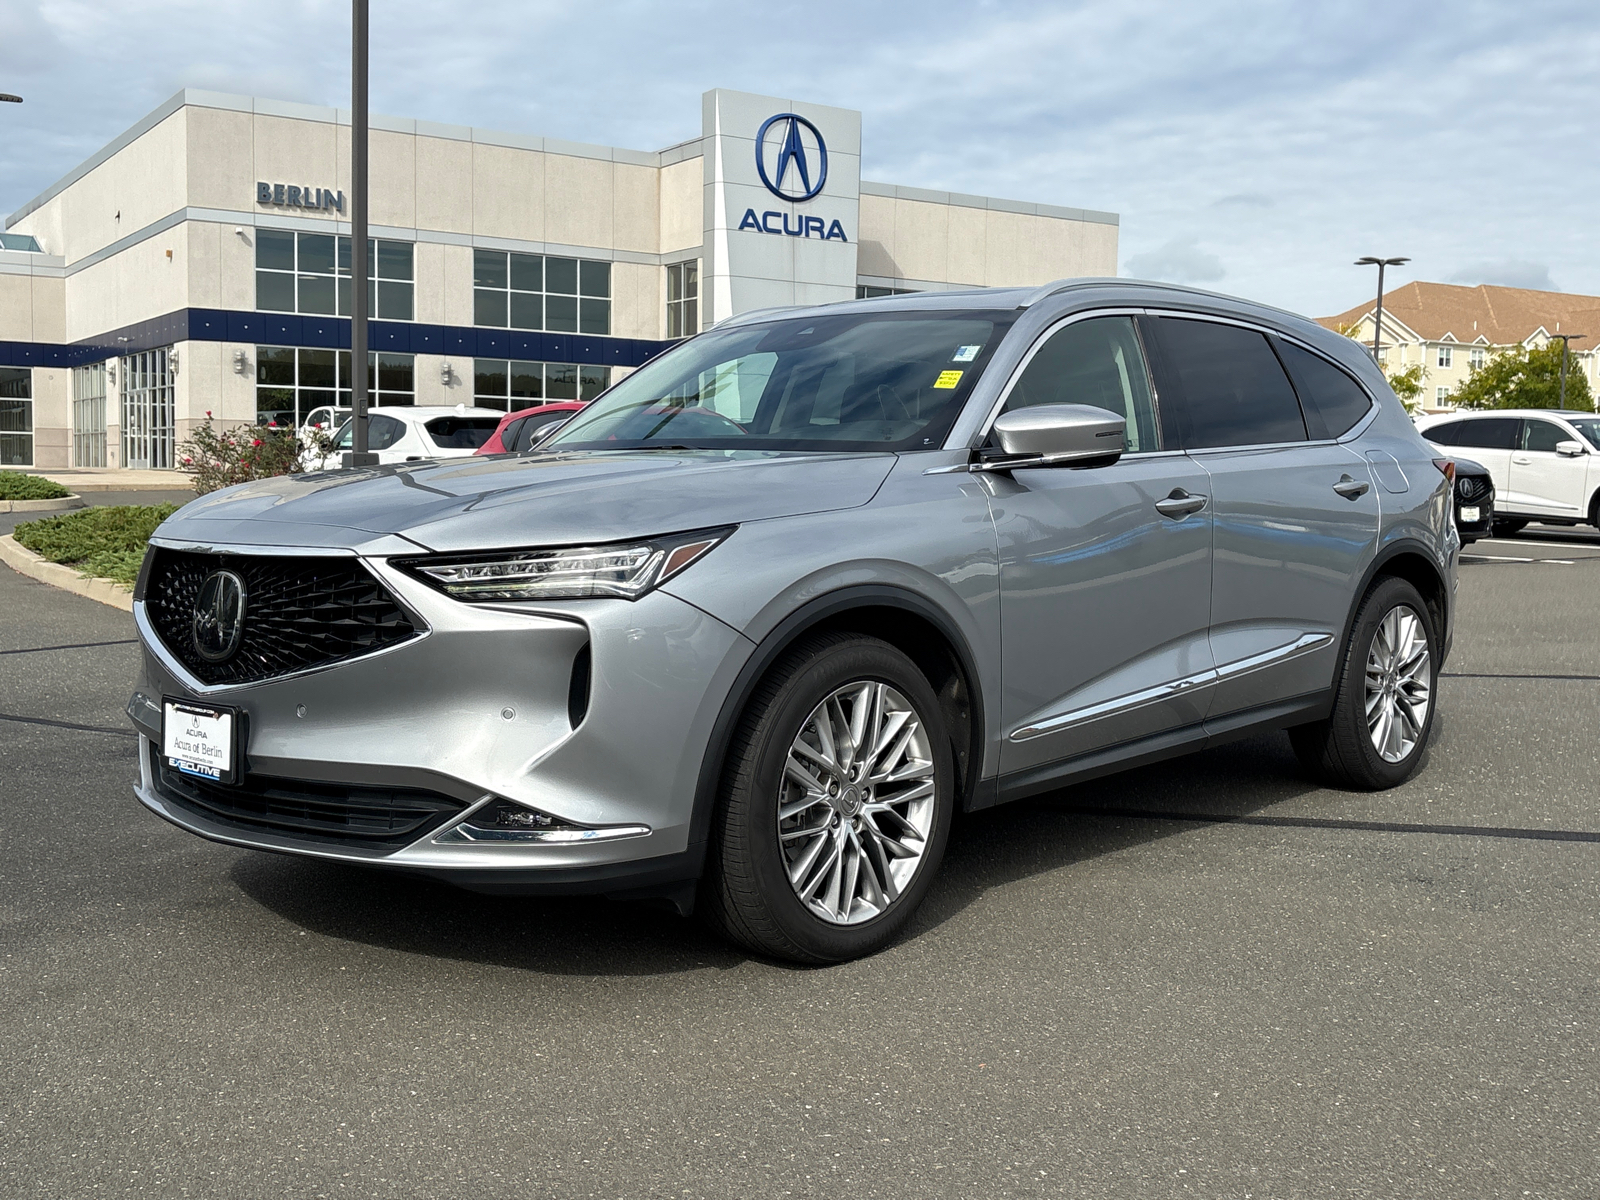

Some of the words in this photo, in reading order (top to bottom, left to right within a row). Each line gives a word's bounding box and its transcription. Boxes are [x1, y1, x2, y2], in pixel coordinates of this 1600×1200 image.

[256, 181, 343, 211] BERLIN
[738, 208, 848, 242] ACURA
[186, 728, 208, 739] ACURA
[174, 737, 191, 751] Acura
[193, 743, 200, 753] of
[201, 742, 223, 758] Berlin
[168, 757, 221, 777] EXECUTIVE
